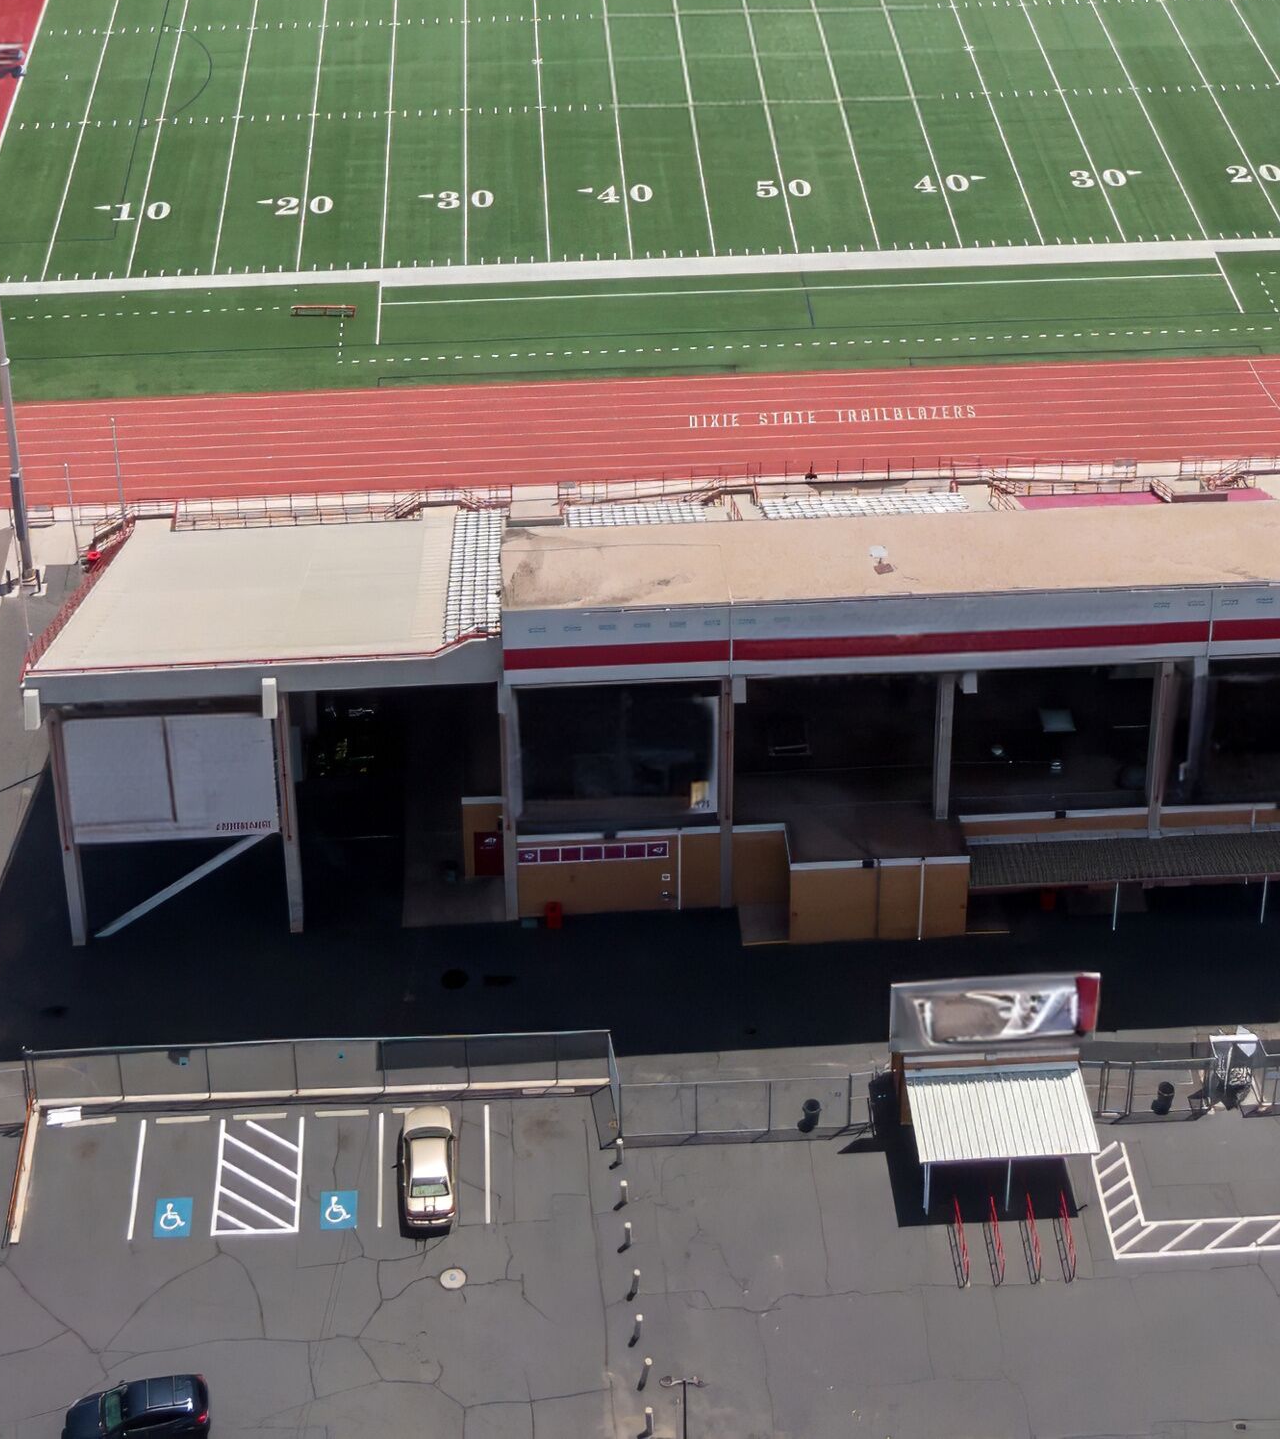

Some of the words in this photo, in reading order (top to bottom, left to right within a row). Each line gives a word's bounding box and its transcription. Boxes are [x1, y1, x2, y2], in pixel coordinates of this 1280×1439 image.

[914, 174, 970, 193] 40
[1070, 169, 1128, 188] 30
[597, 183, 653, 204] 40
[755, 179, 812, 199] 50
[274, 195, 334, 216] 20
[437, 189, 494, 210] 30
[110, 201, 172, 221] 10
[689, 414, 741, 428] DIXIE
[758, 410, 817, 426] STATE
[836, 405, 978, 423] TRAILBLAZERS
